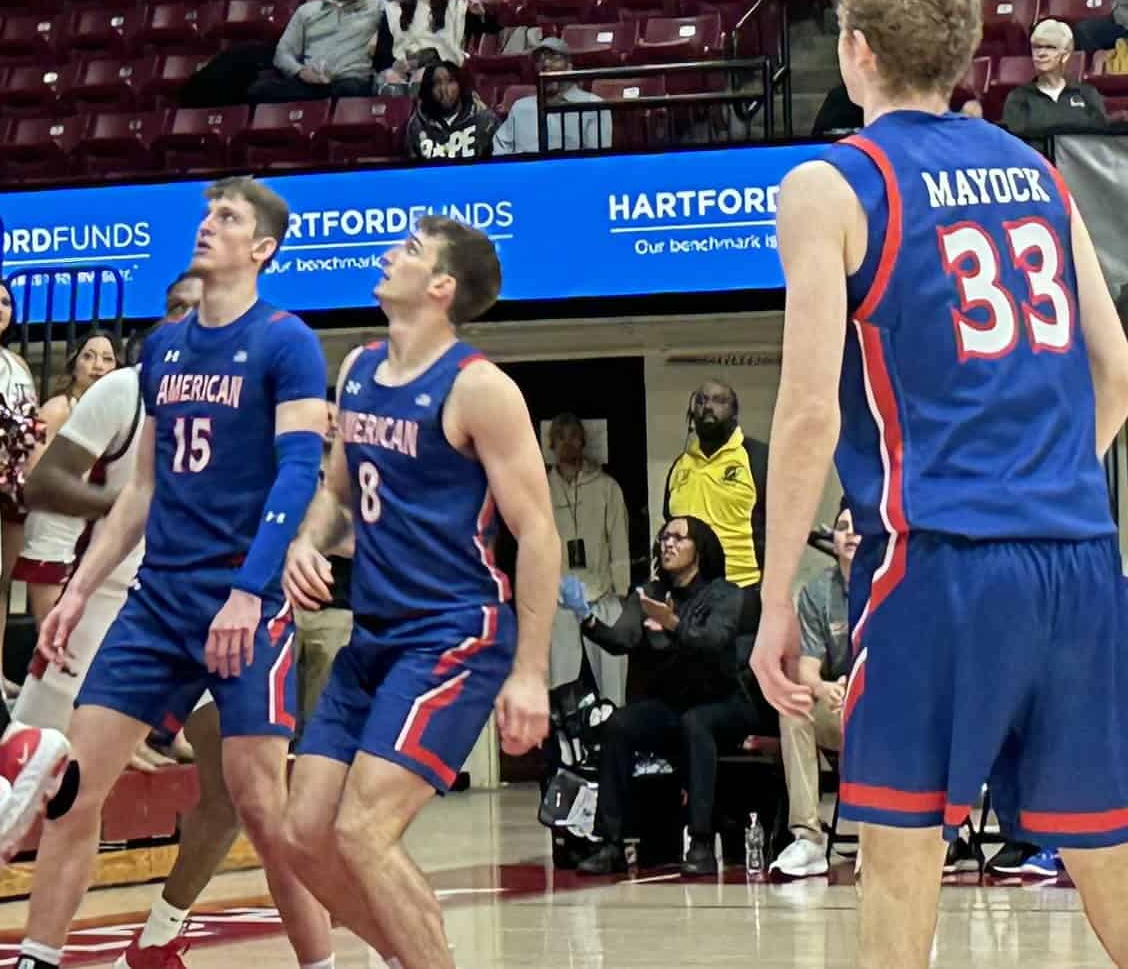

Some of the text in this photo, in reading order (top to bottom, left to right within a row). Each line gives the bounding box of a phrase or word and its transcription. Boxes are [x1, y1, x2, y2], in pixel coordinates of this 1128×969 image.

[921, 167, 1052, 208] MAYOCK
[634, 239, 665, 256] Our
[669, 233, 761, 254] benchmark
[936, 215, 1075, 364] 33
[156, 374, 244, 409] AMERICAN
[171, 415, 214, 474] 15
[339, 409, 420, 459] MERICAN
[358, 460, 382, 524] 8
